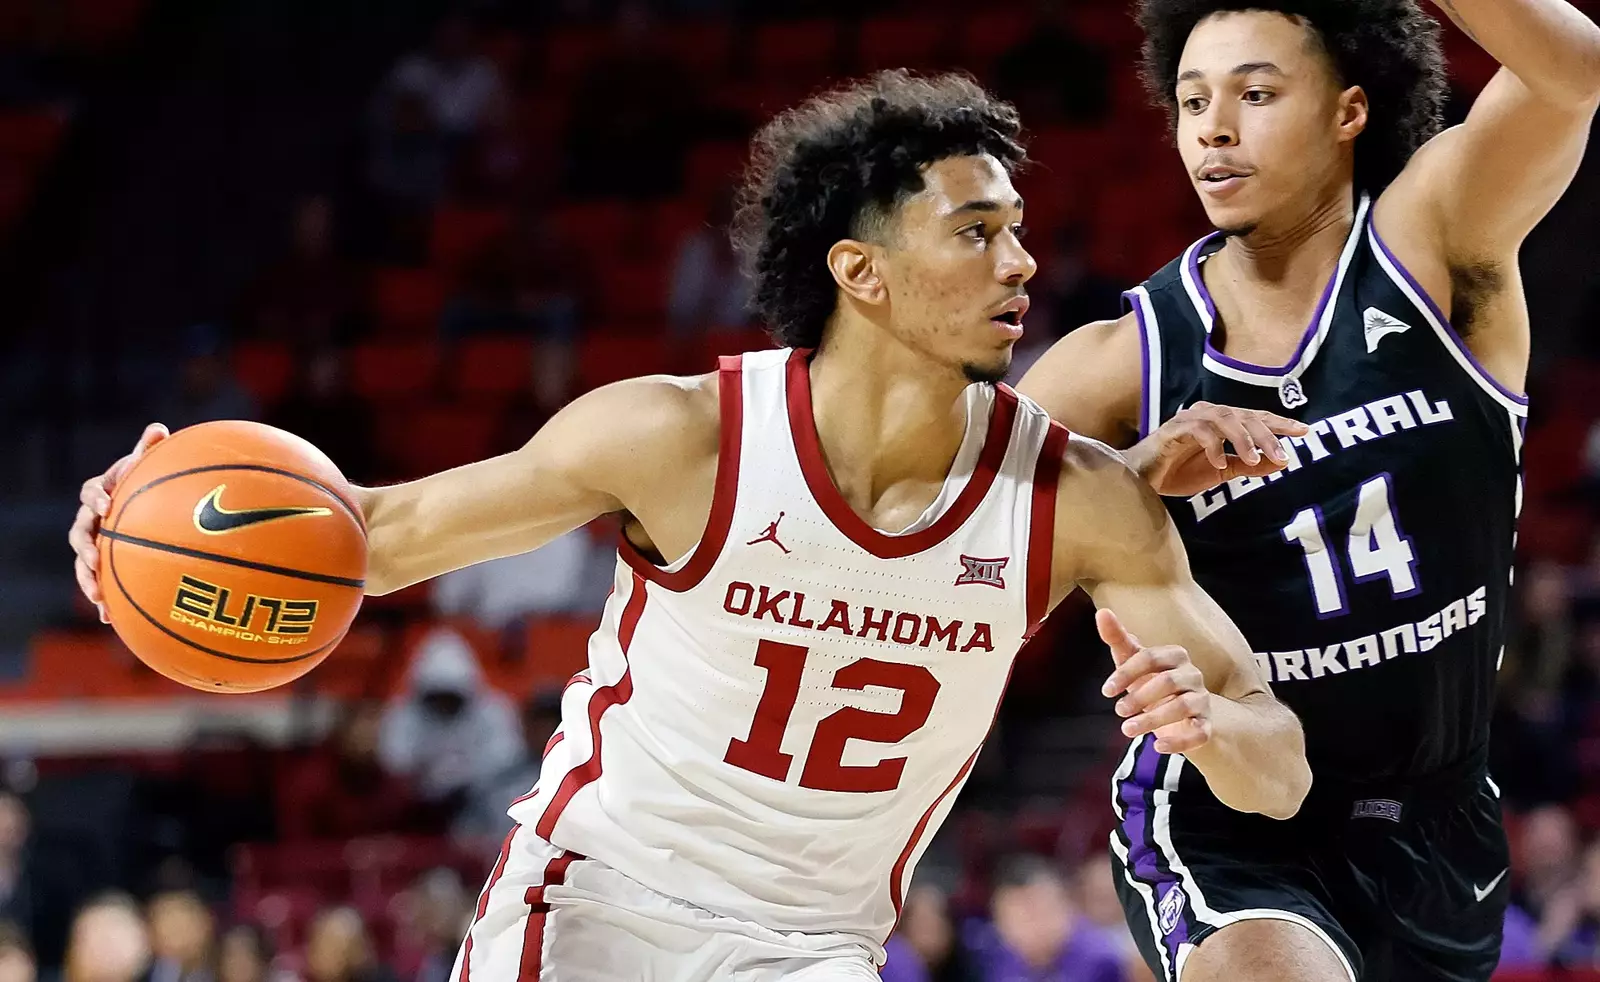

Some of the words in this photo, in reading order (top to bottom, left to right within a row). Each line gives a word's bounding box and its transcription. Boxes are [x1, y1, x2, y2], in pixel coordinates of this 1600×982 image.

[957, 556, 1007, 587] XII
[1281, 472, 1422, 619] 14
[170, 610, 309, 645] CHAMPIONSHIP
[173, 573, 320, 635] ELITE
[723, 581, 995, 653] OKLAHOMA
[722, 638, 942, 794] 12
